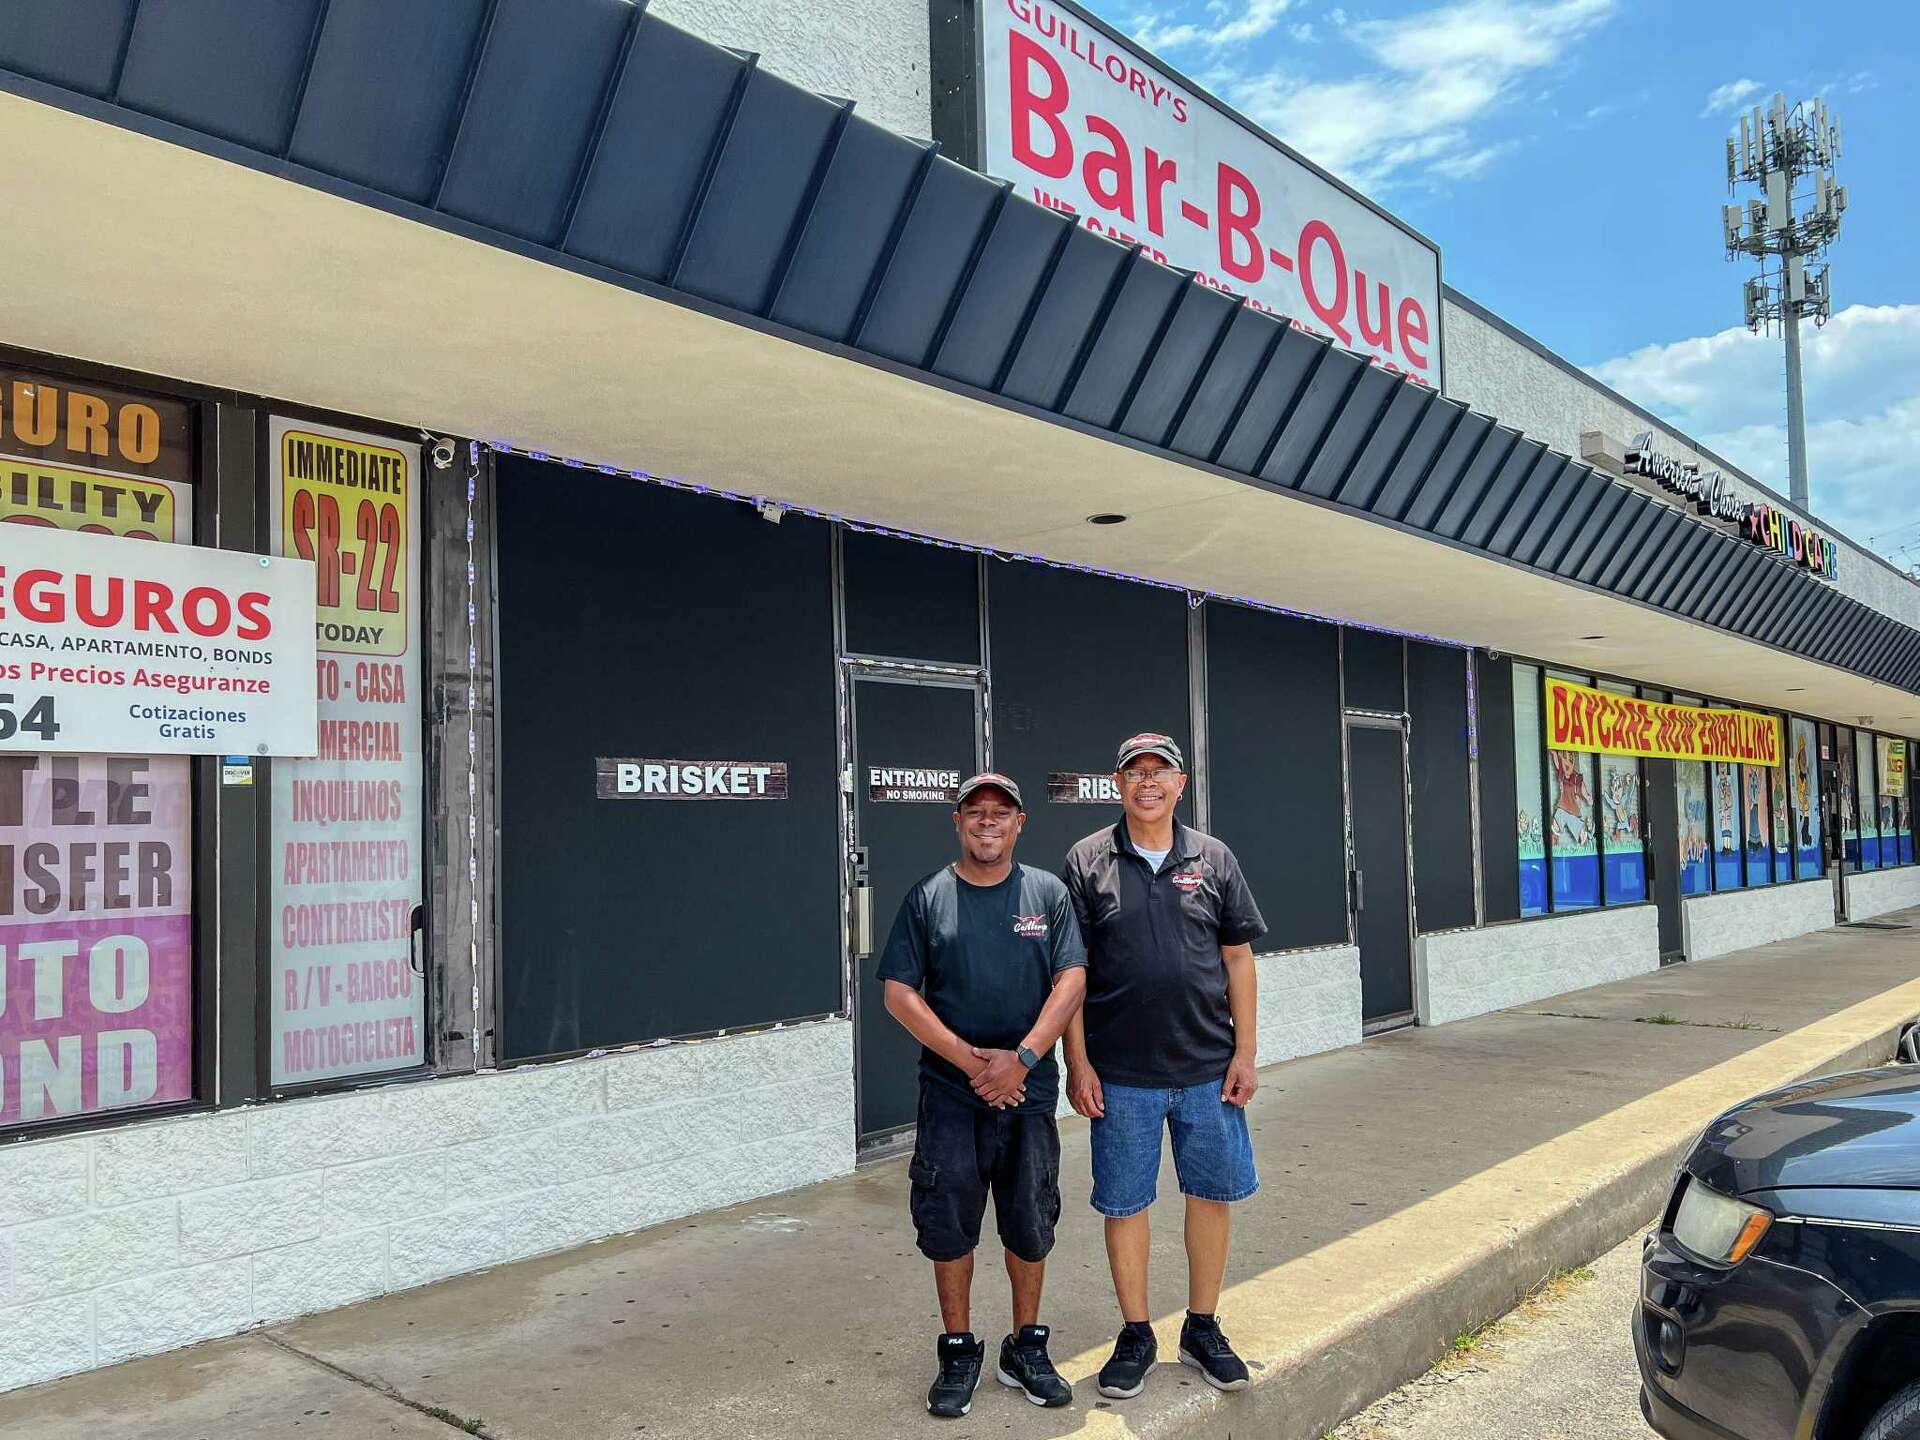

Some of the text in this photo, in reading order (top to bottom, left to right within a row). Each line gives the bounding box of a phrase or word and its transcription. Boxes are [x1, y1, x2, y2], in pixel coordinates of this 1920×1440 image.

[1008, 0, 1188, 123] GUILLORY'S
[1009, 29, 1429, 370] Bar-B-Que
[0, 380, 160, 464] URO
[288, 438, 401, 495] IMMEDIATE
[0, 471, 165, 523] ILITY
[293, 488, 400, 613] SR-22
[1759, 503, 1803, 562] CHILD
[0, 565, 272, 641] GUROS
[61, 636, 208, 663] APARTAMENTO,
[213, 648, 273, 665] BONDS
[316, 622, 384, 644] TODAY
[30, 662, 126, 686] Precios
[132, 668, 271, 694] Aseguranze
[355, 662, 405, 704] CASA
[129, 703, 247, 723] Cotizaciones
[159, 723, 216, 740] Gratis
[1553, 686, 1775, 762] DAYCARE NOW ENROLLING
[292, 779, 401, 827] INQUILINOS
[616, 763, 771, 794] BRISKET
[870, 768, 959, 789] ENTRANCE
[886, 789, 945, 802] NO SMOKING
[1078, 778, 1122, 800] RIBS
[283, 840, 408, 886] APARTAMENTO
[282, 898, 411, 949] CONTRATISTA
[0, 934, 150, 1021] TO
[346, 957, 412, 1004] BARCO
[283, 1016, 416, 1074] MOTOCICLETA
[0, 1027, 158, 1121] ND
